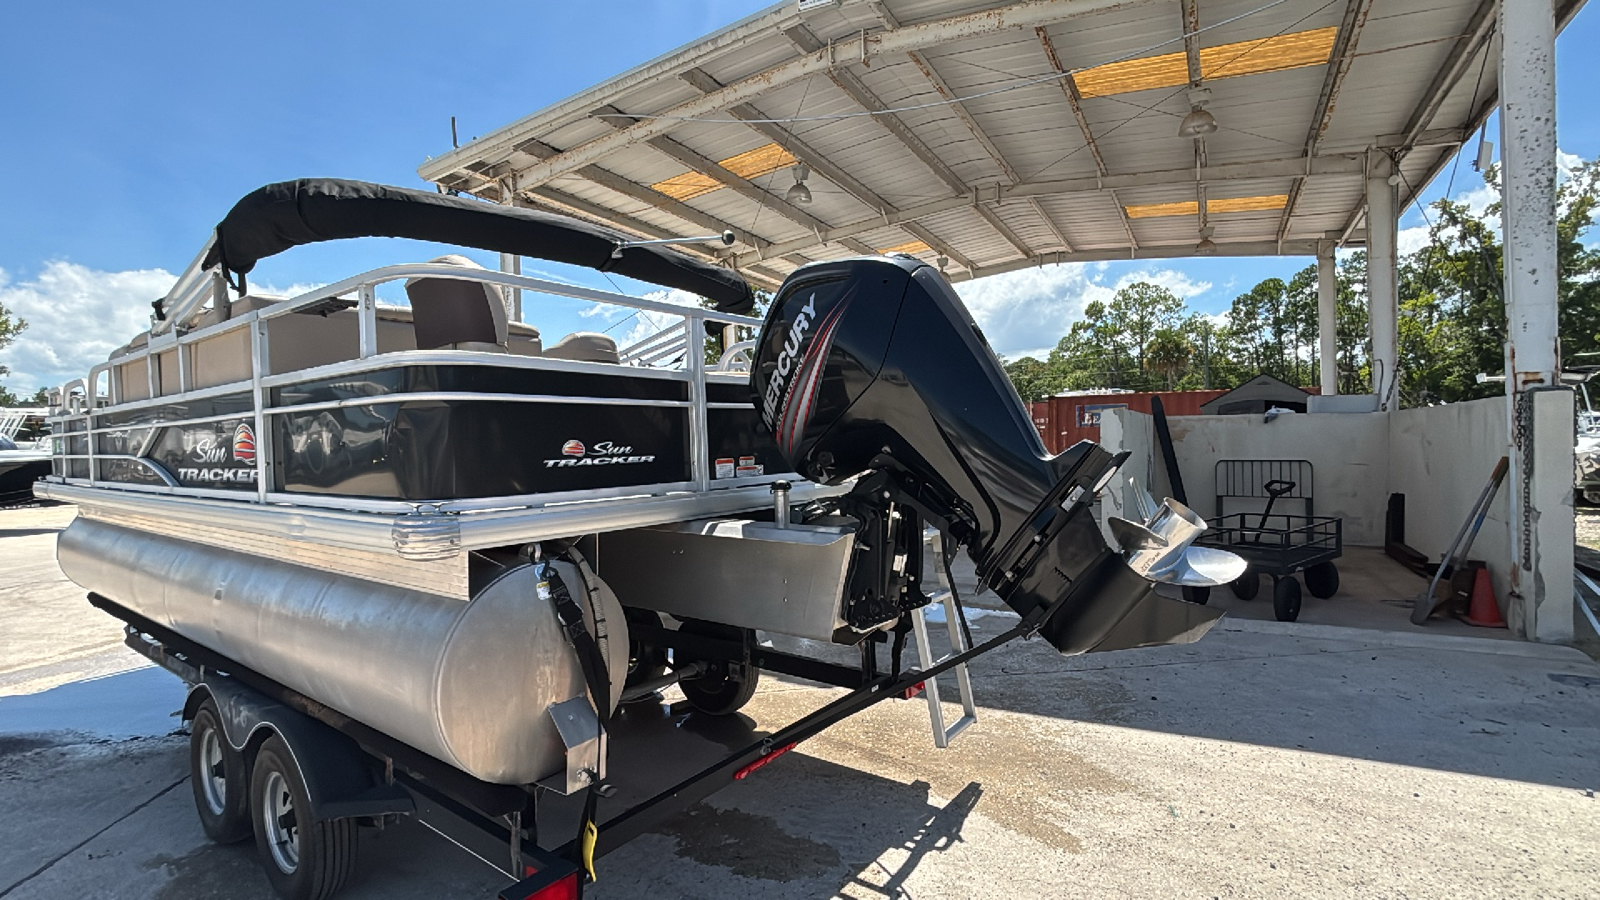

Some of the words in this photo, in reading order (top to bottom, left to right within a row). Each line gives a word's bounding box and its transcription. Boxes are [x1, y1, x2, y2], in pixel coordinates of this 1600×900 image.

[762, 292, 817, 433] MERCURY
[192, 438, 227, 463] Sun
[587, 441, 633, 455] Sun
[543, 455, 655, 469] TRACKER
[177, 467, 258, 484] TRACKER
